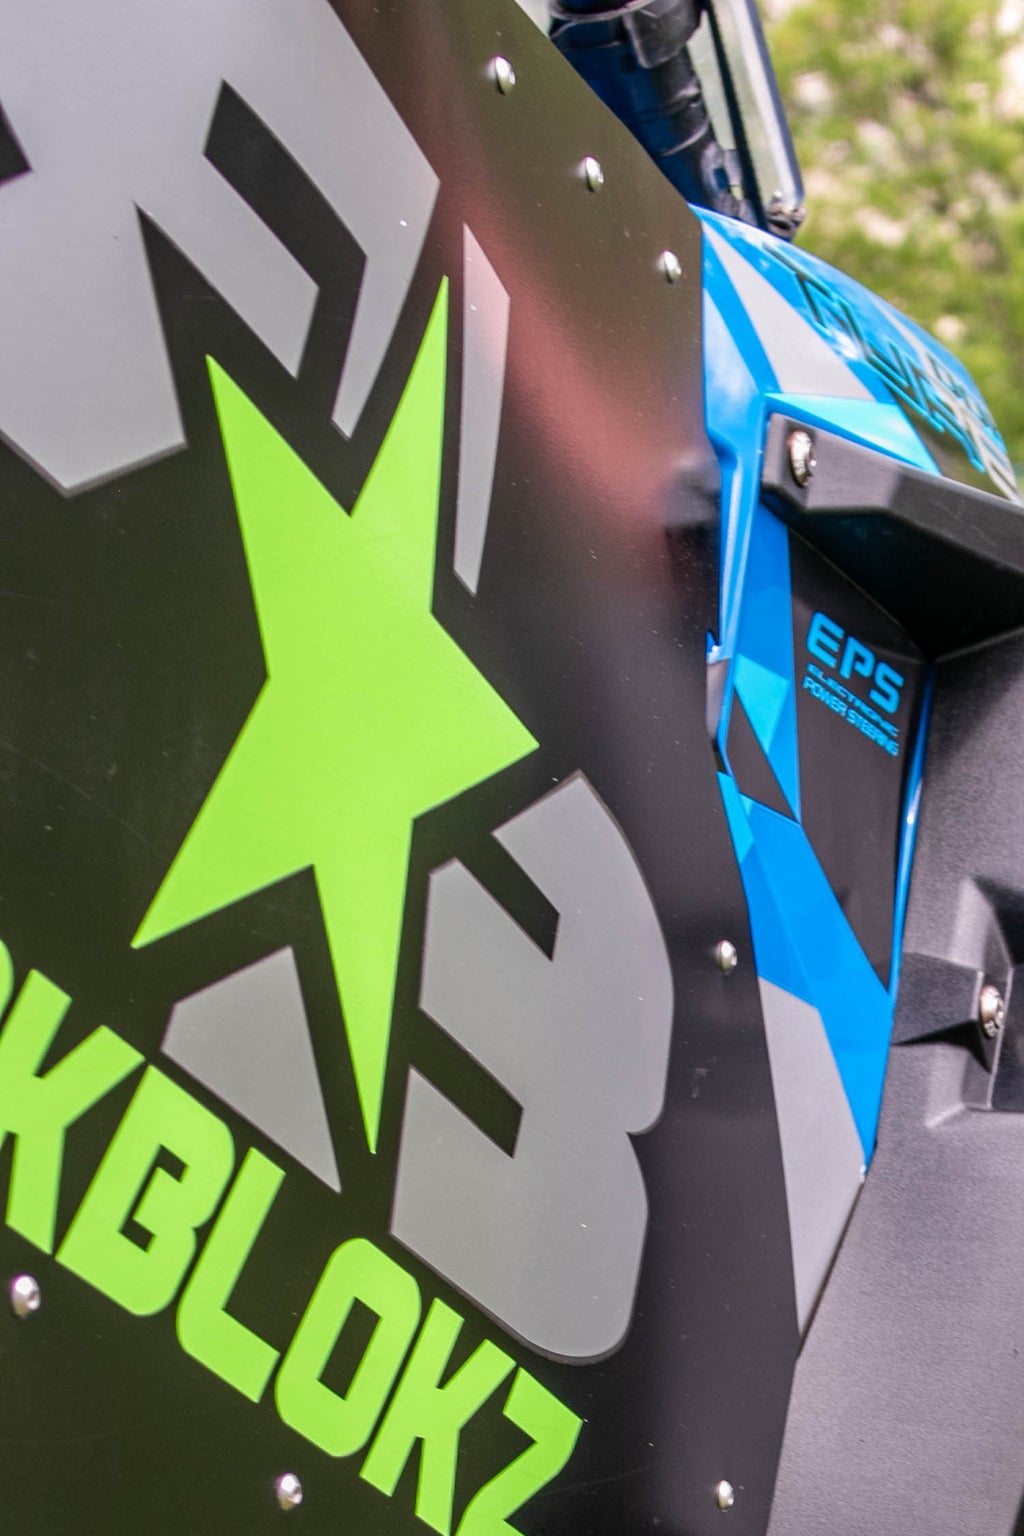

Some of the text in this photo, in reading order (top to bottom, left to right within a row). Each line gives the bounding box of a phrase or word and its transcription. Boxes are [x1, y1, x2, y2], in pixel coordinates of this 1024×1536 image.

[806, 611, 905, 714] EPS
[801, 675, 900, 757] POWER STEERING
